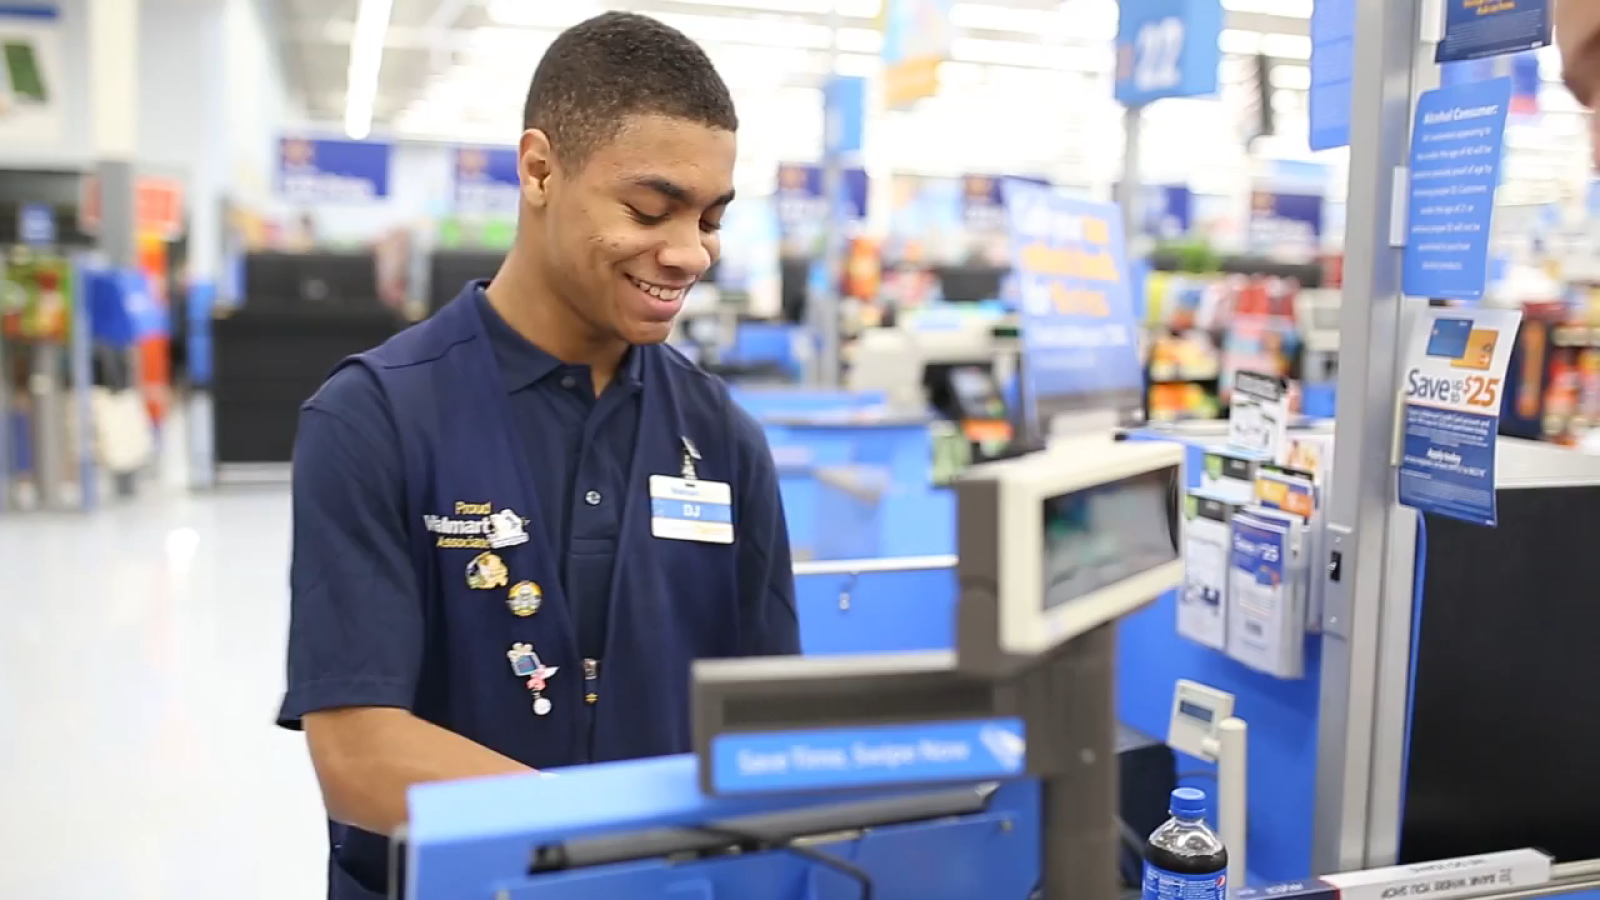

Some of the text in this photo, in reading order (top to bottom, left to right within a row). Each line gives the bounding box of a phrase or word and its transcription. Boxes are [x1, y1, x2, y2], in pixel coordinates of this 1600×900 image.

[1135, 17, 1185, 89] 22
[1423, 108, 1453, 125] Alcohol
[1405, 369, 1451, 401] Save
[1463, 375, 1501, 407] $25
[455, 500, 492, 516] Proud
[683, 504, 701, 519] DJ
[423, 514, 491, 535] Walmart
[738, 737, 971, 775] Save Time, Swipe Now
[1380, 873, 1496, 900] BANK WHERE YOU SHOP
